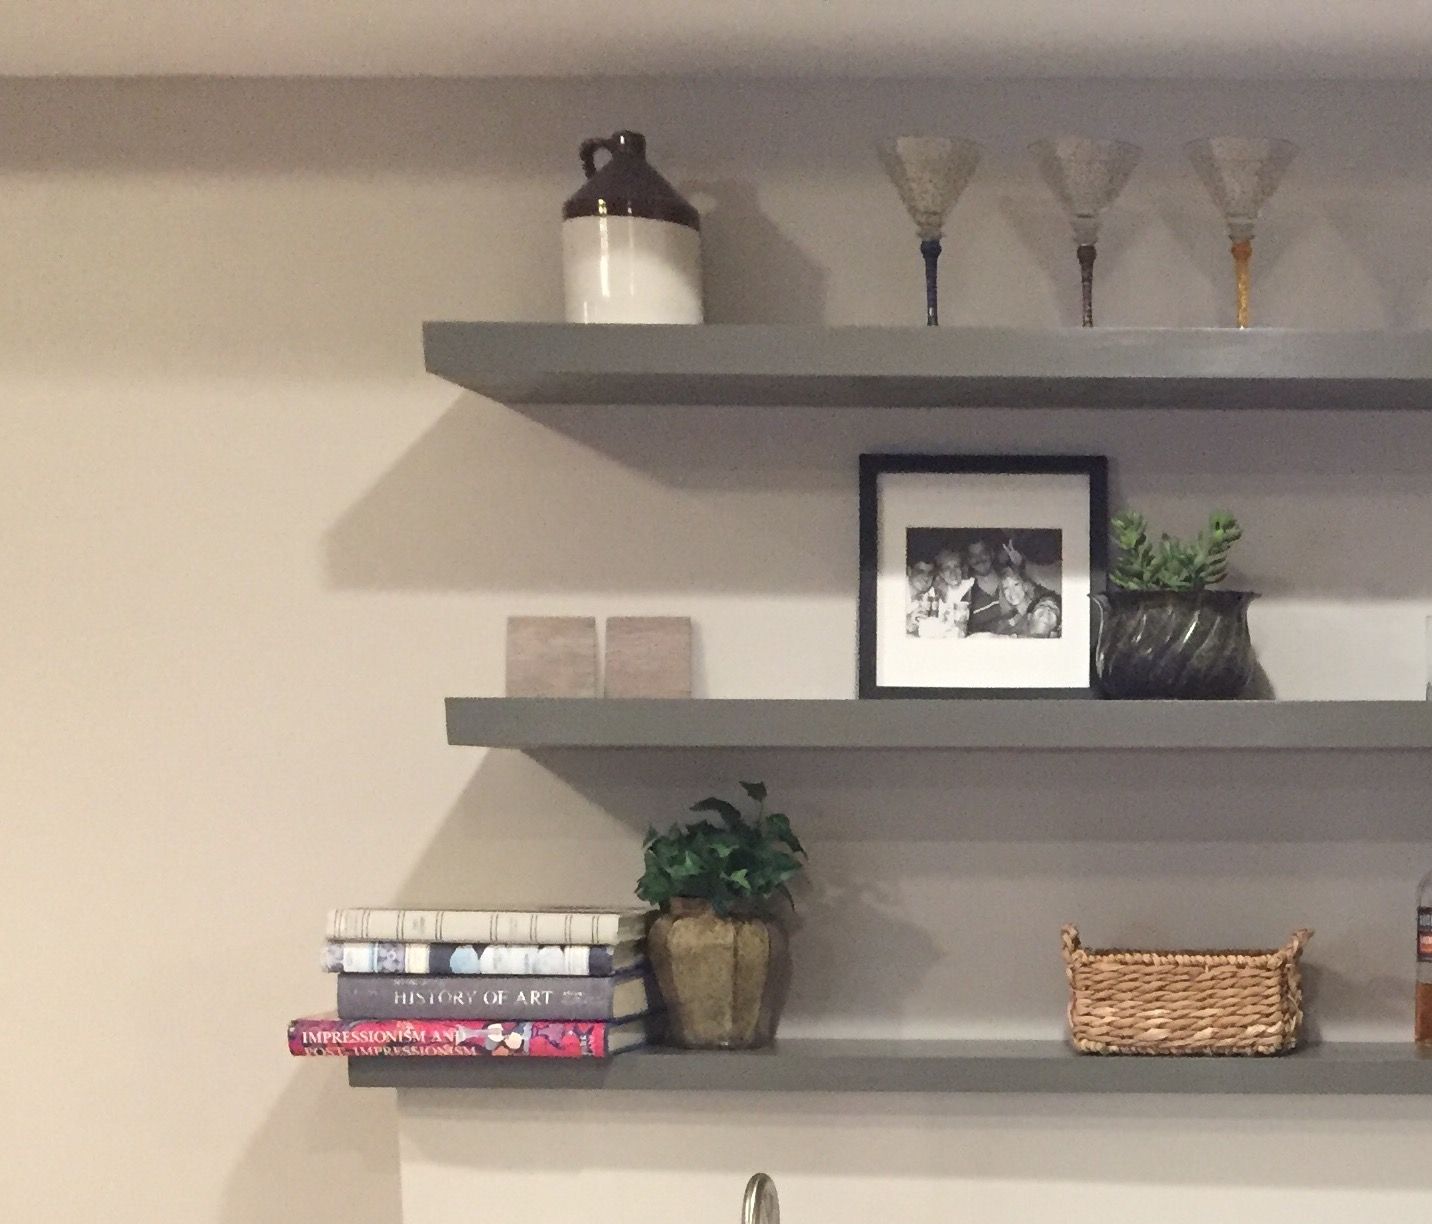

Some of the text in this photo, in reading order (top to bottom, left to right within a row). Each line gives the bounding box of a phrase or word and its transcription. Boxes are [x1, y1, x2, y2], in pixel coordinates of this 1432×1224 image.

[394, 990, 477, 1006] HISTORY
[483, 990, 507, 1005] OF
[516, 990, 553, 1006] ART
[302, 1030, 425, 1045] IMPRESSIONISM
